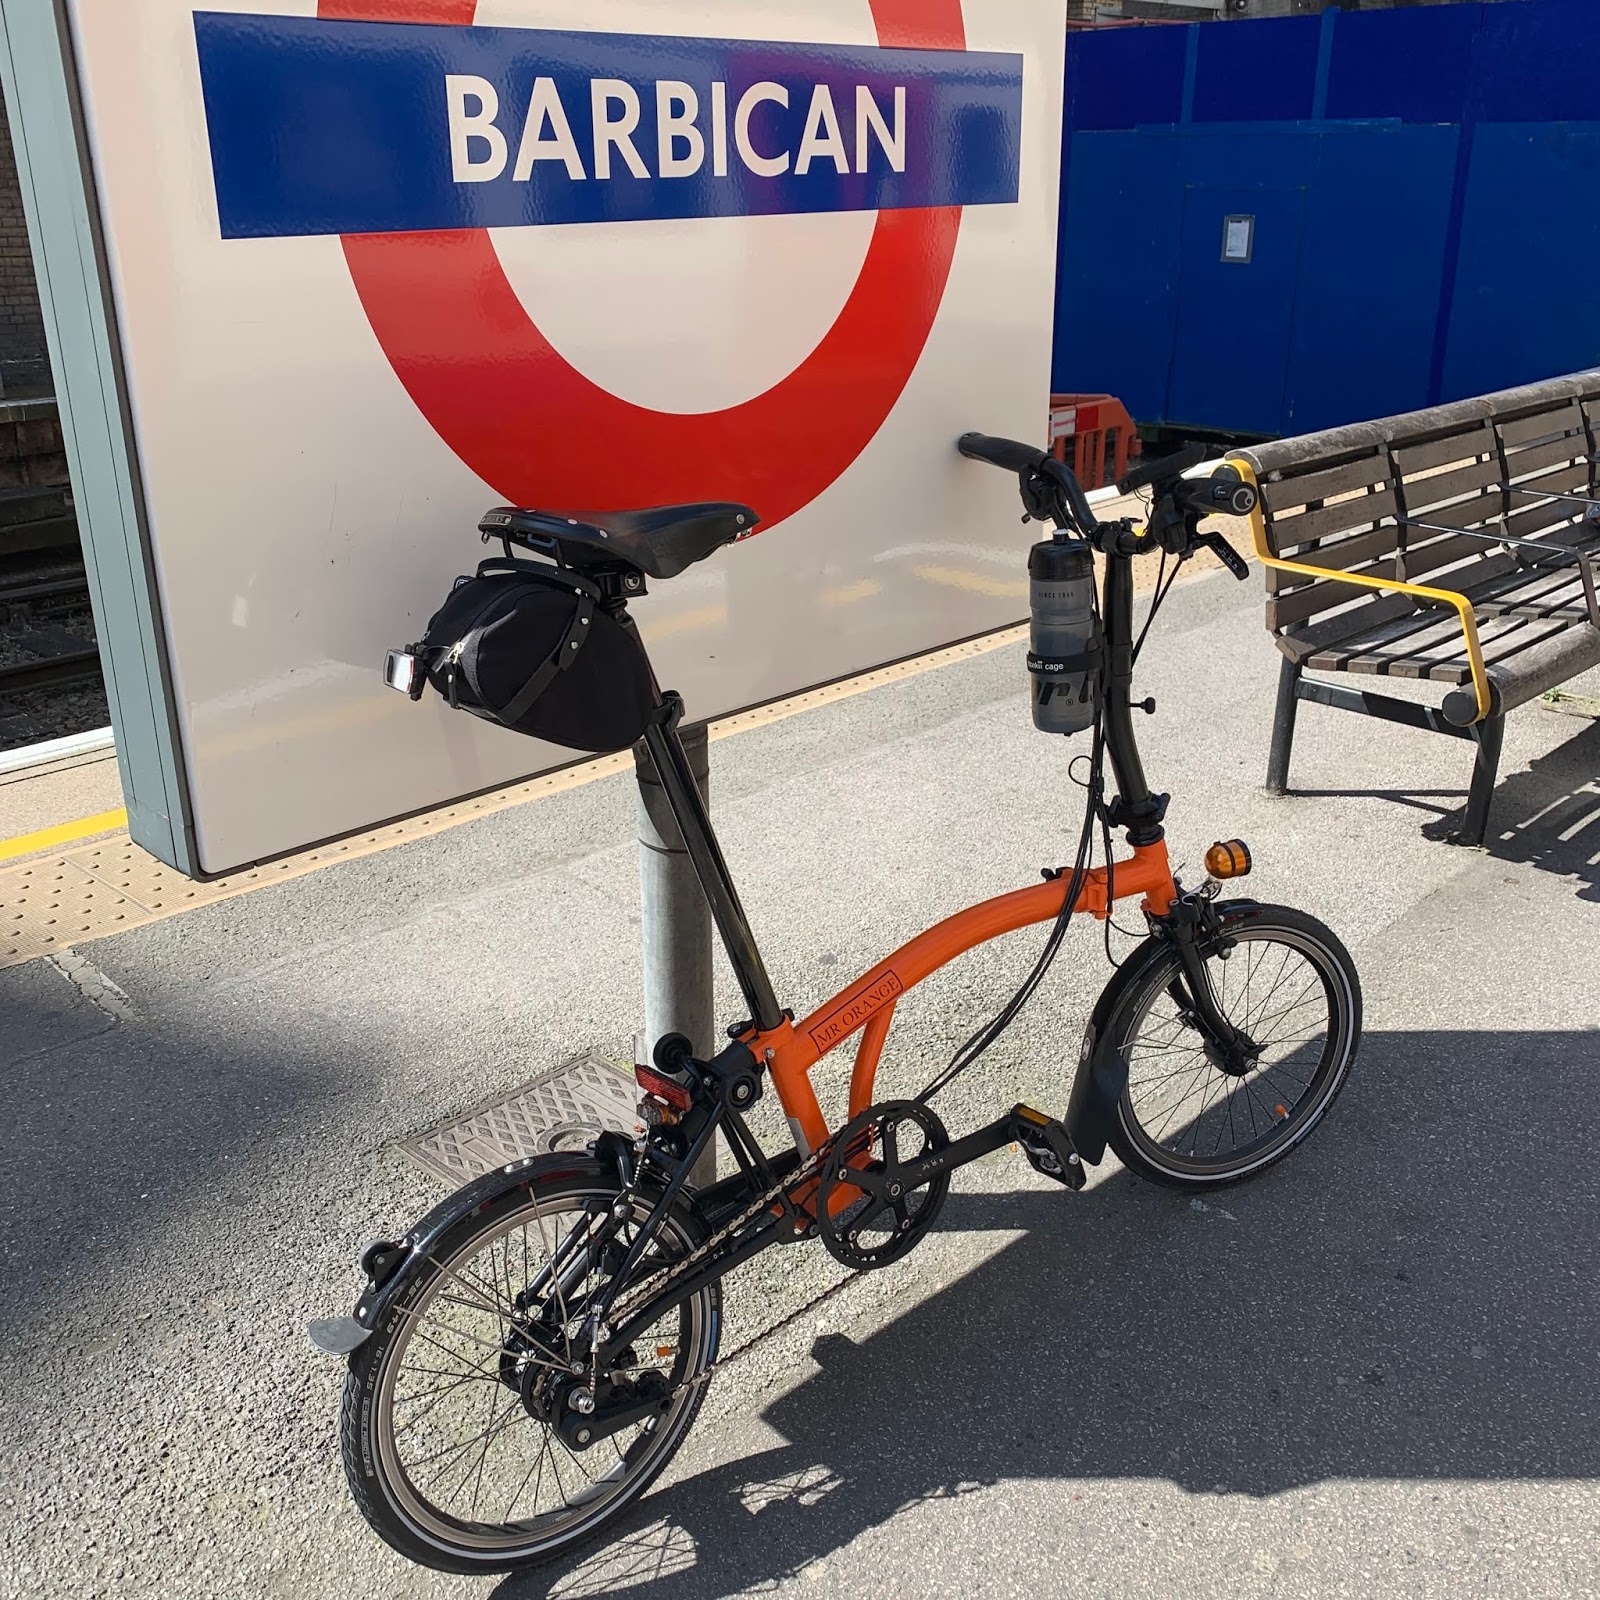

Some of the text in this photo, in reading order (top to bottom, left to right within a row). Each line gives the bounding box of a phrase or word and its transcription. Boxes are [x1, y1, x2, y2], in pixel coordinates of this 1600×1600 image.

[446, 74, 906, 183] BARBICAN
[1044, 663, 1064, 672] cage
[817, 977, 899, 1046] MR ORANGE
